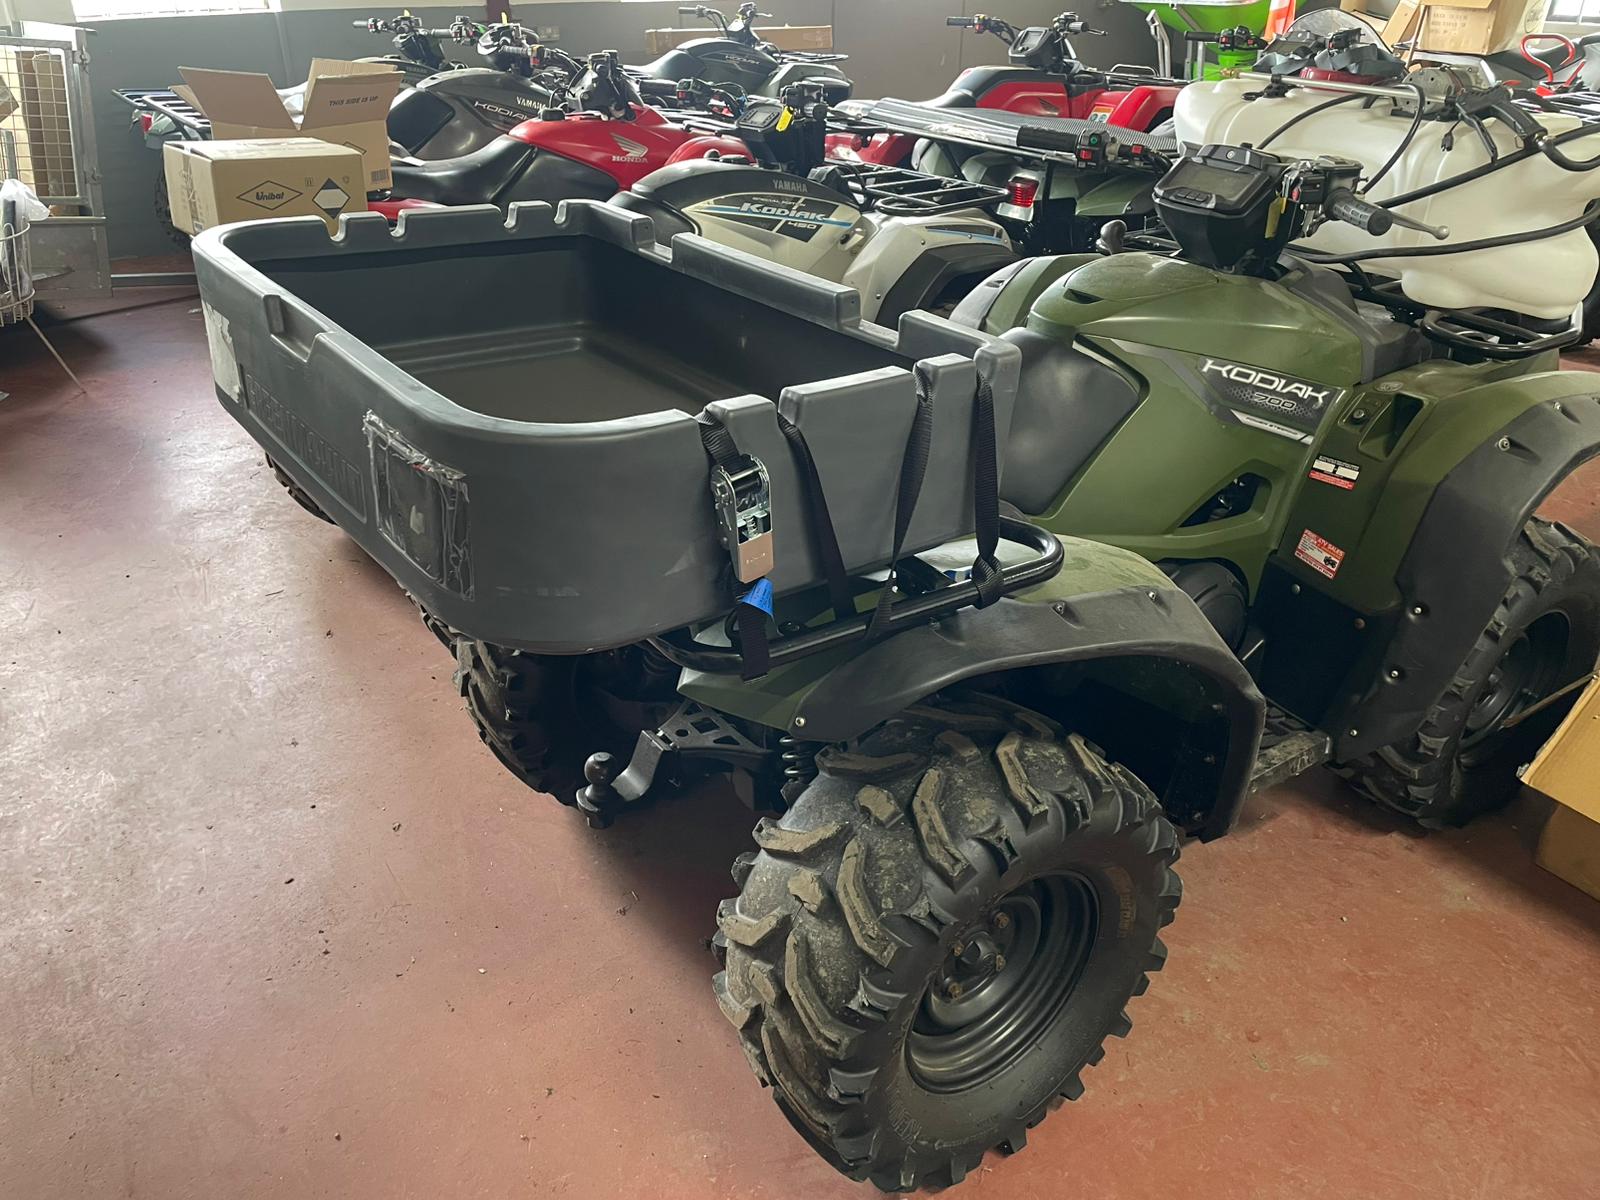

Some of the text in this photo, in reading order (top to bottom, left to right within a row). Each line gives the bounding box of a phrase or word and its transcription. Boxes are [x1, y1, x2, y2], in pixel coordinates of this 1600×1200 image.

[329, 99, 344, 107] THIS
[345, 97, 360, 105] SIDE
[611, 155, 648, 163] HONDA
[772, 179, 808, 193] YAMAHA
[1202, 358, 1331, 404] KODIAK
[1254, 391, 1297, 410] 700
